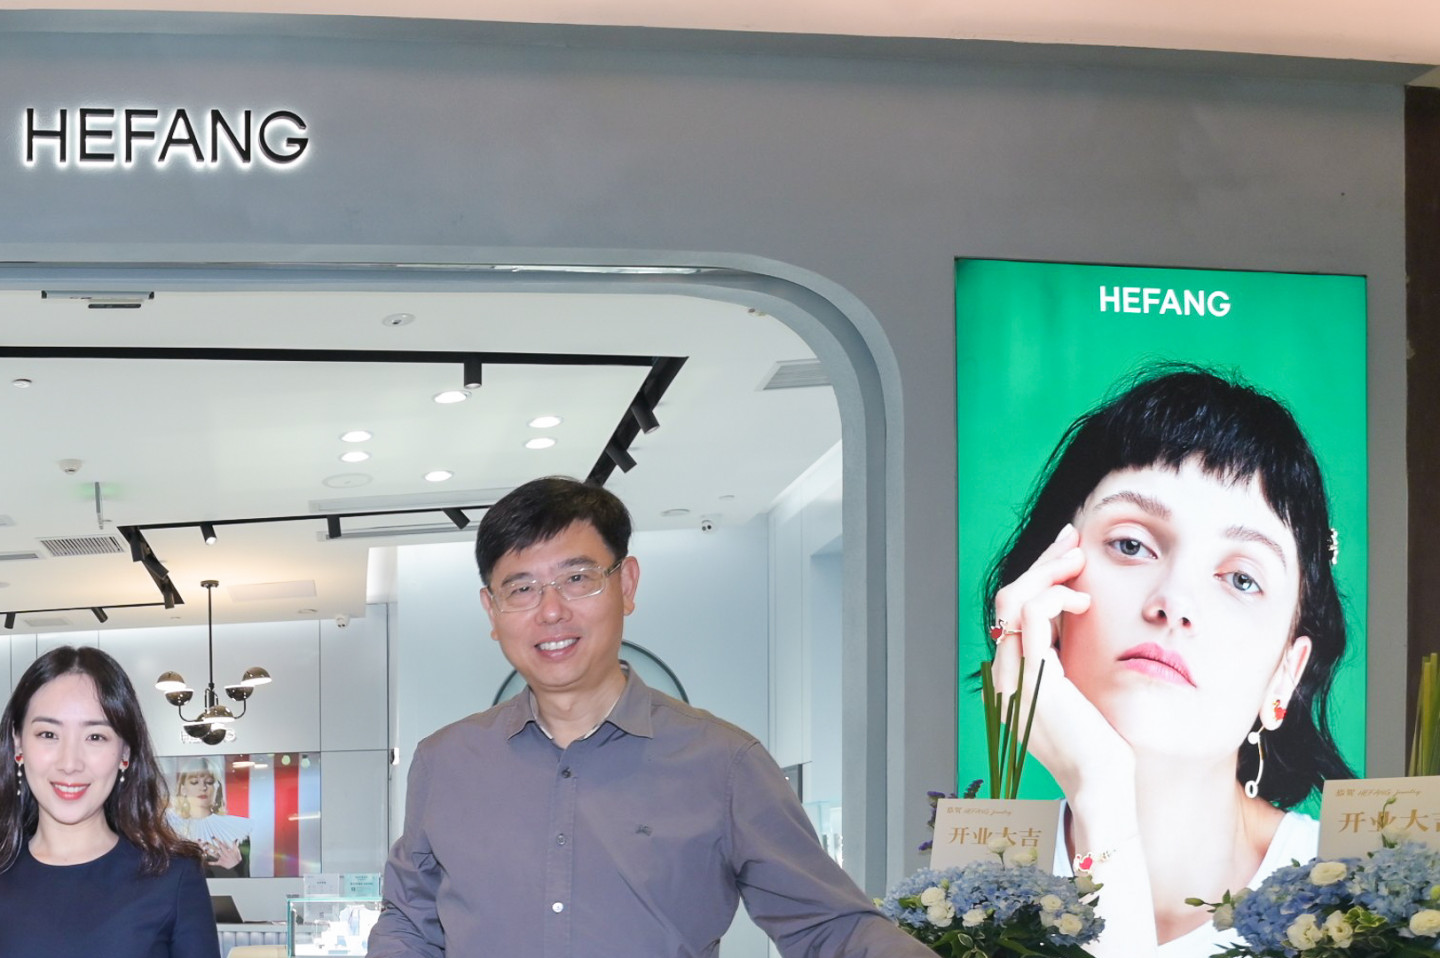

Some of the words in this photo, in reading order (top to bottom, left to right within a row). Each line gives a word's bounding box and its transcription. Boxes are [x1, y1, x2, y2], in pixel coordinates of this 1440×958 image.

[26, 107, 309, 164] HEFANG
[1099, 285, 1232, 317] HEFANG
[948, 826, 1043, 848] 开业大吉
